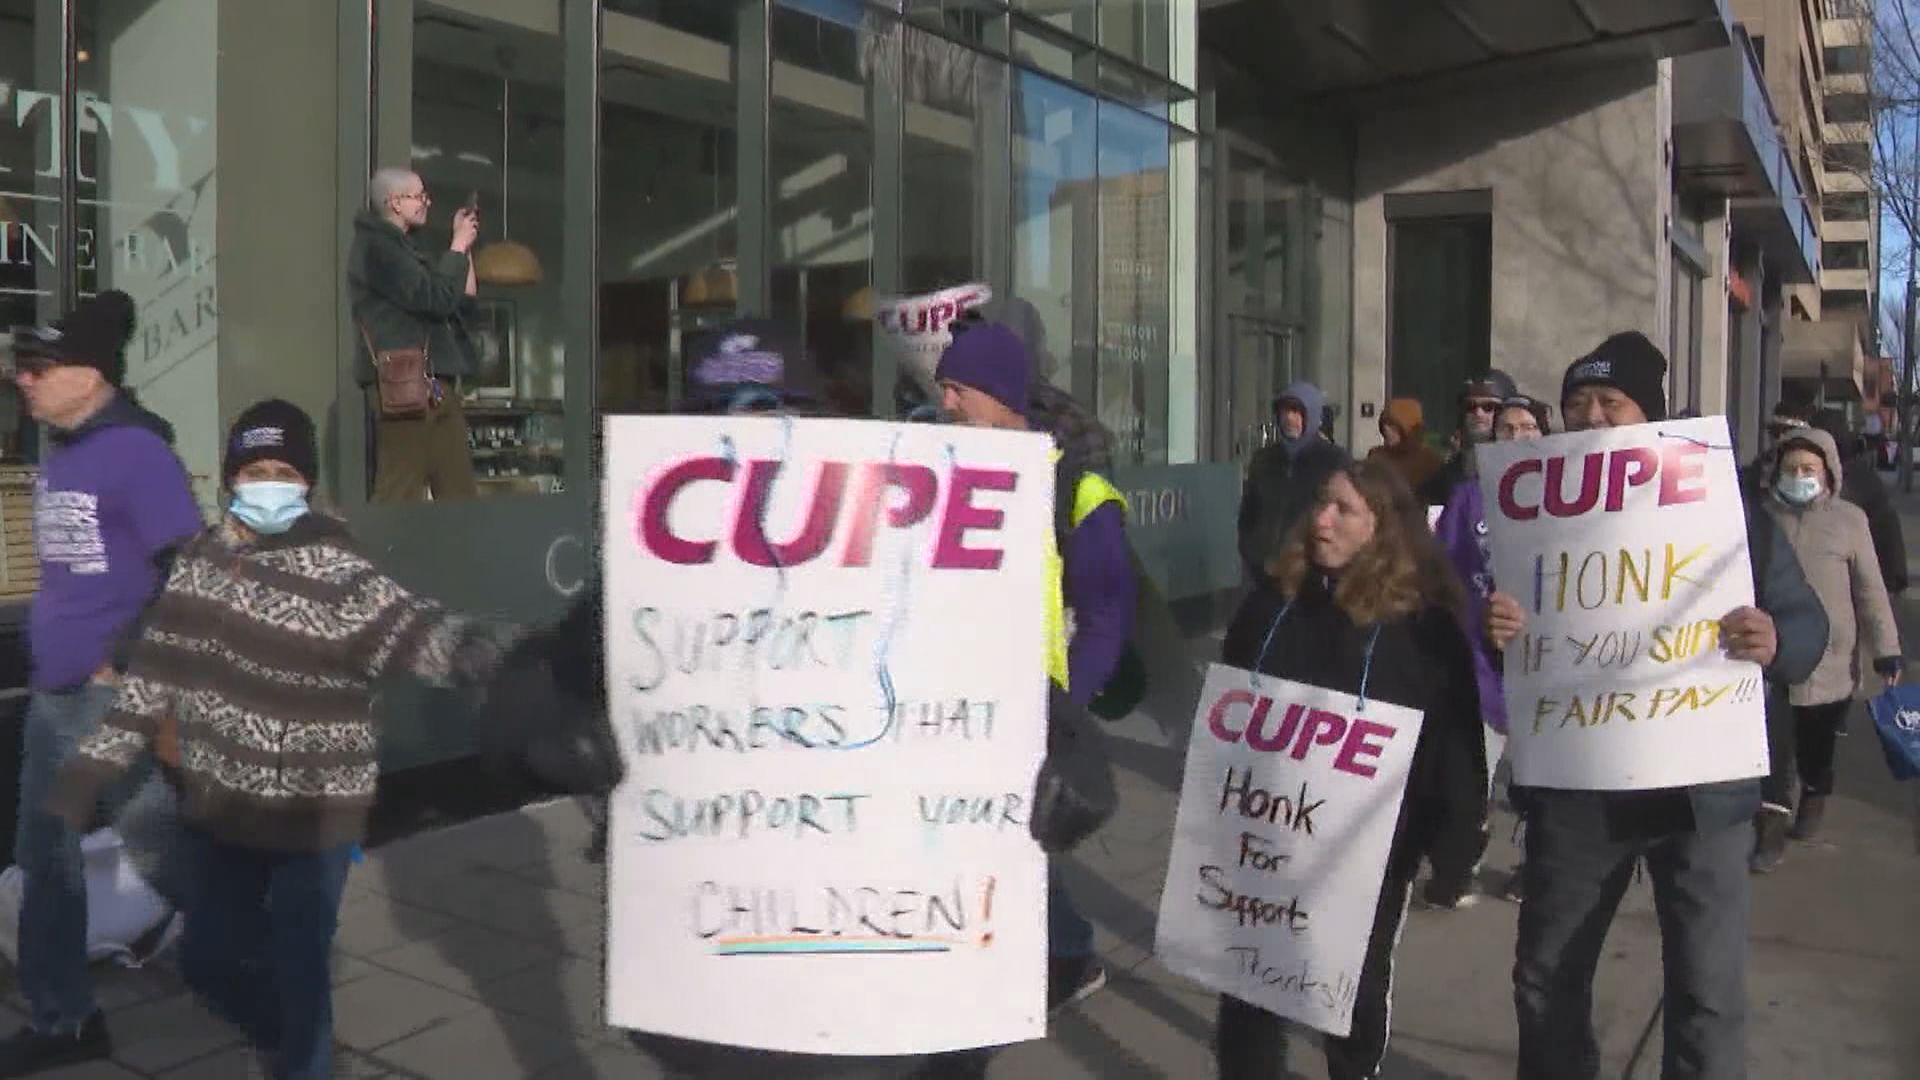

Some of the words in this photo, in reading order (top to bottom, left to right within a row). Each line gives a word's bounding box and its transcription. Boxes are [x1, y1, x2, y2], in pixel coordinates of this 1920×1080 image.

[633, 456, 1018, 570] CUPE
[1497, 442, 1708, 522] CUPE
[1534, 542, 1709, 616] HONK
[630, 606, 872, 691] SUPPORT
[1521, 633, 1553, 675] IF
[1566, 631, 1641, 668] YOU
[630, 703, 845, 753] WORKERS
[1208, 689, 1396, 780] CUPE
[1530, 692, 1637, 736] FAIR
[638, 788, 872, 842] SUPPORT
[1219, 766, 1327, 836] Honk
[1237, 831, 1293, 873] For
[1196, 864, 1310, 931] Support
